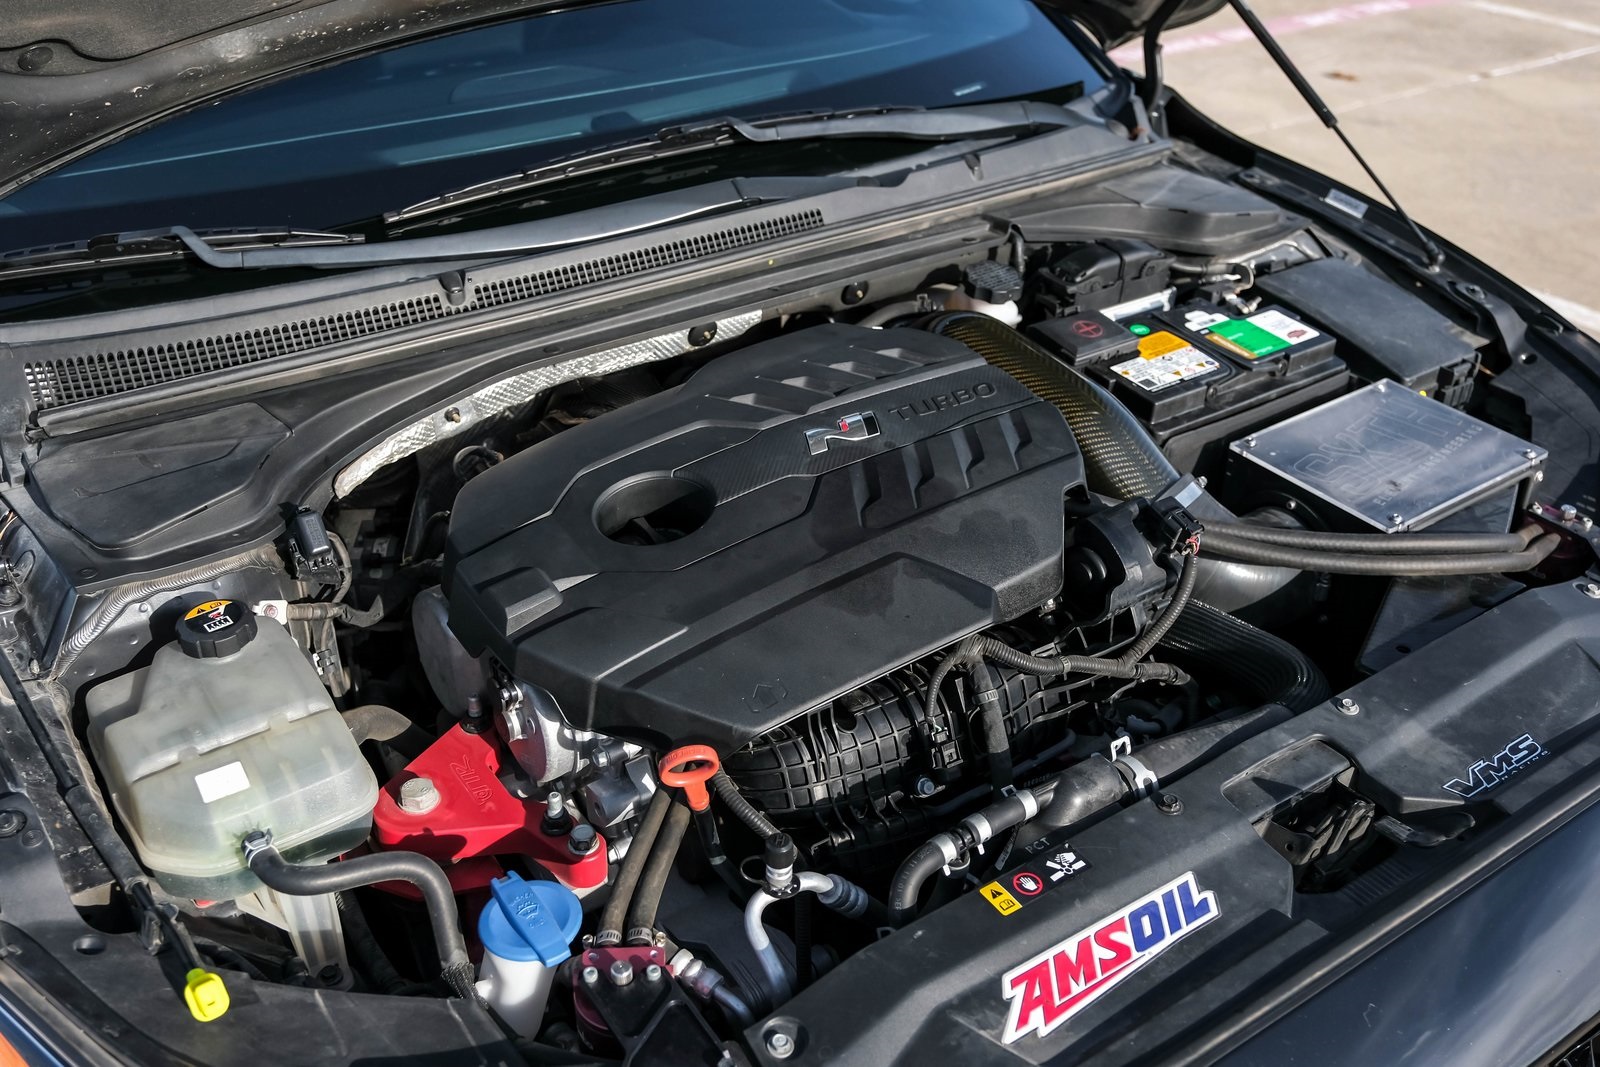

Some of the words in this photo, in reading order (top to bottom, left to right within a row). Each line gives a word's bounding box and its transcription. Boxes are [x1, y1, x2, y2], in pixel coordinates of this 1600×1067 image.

[888, 382, 997, 421] TURBO
[1442, 733, 1541, 798] VMS
[1024, 837, 1050, 854] PCT
[1009, 879, 1212, 1033] AMSOIL
